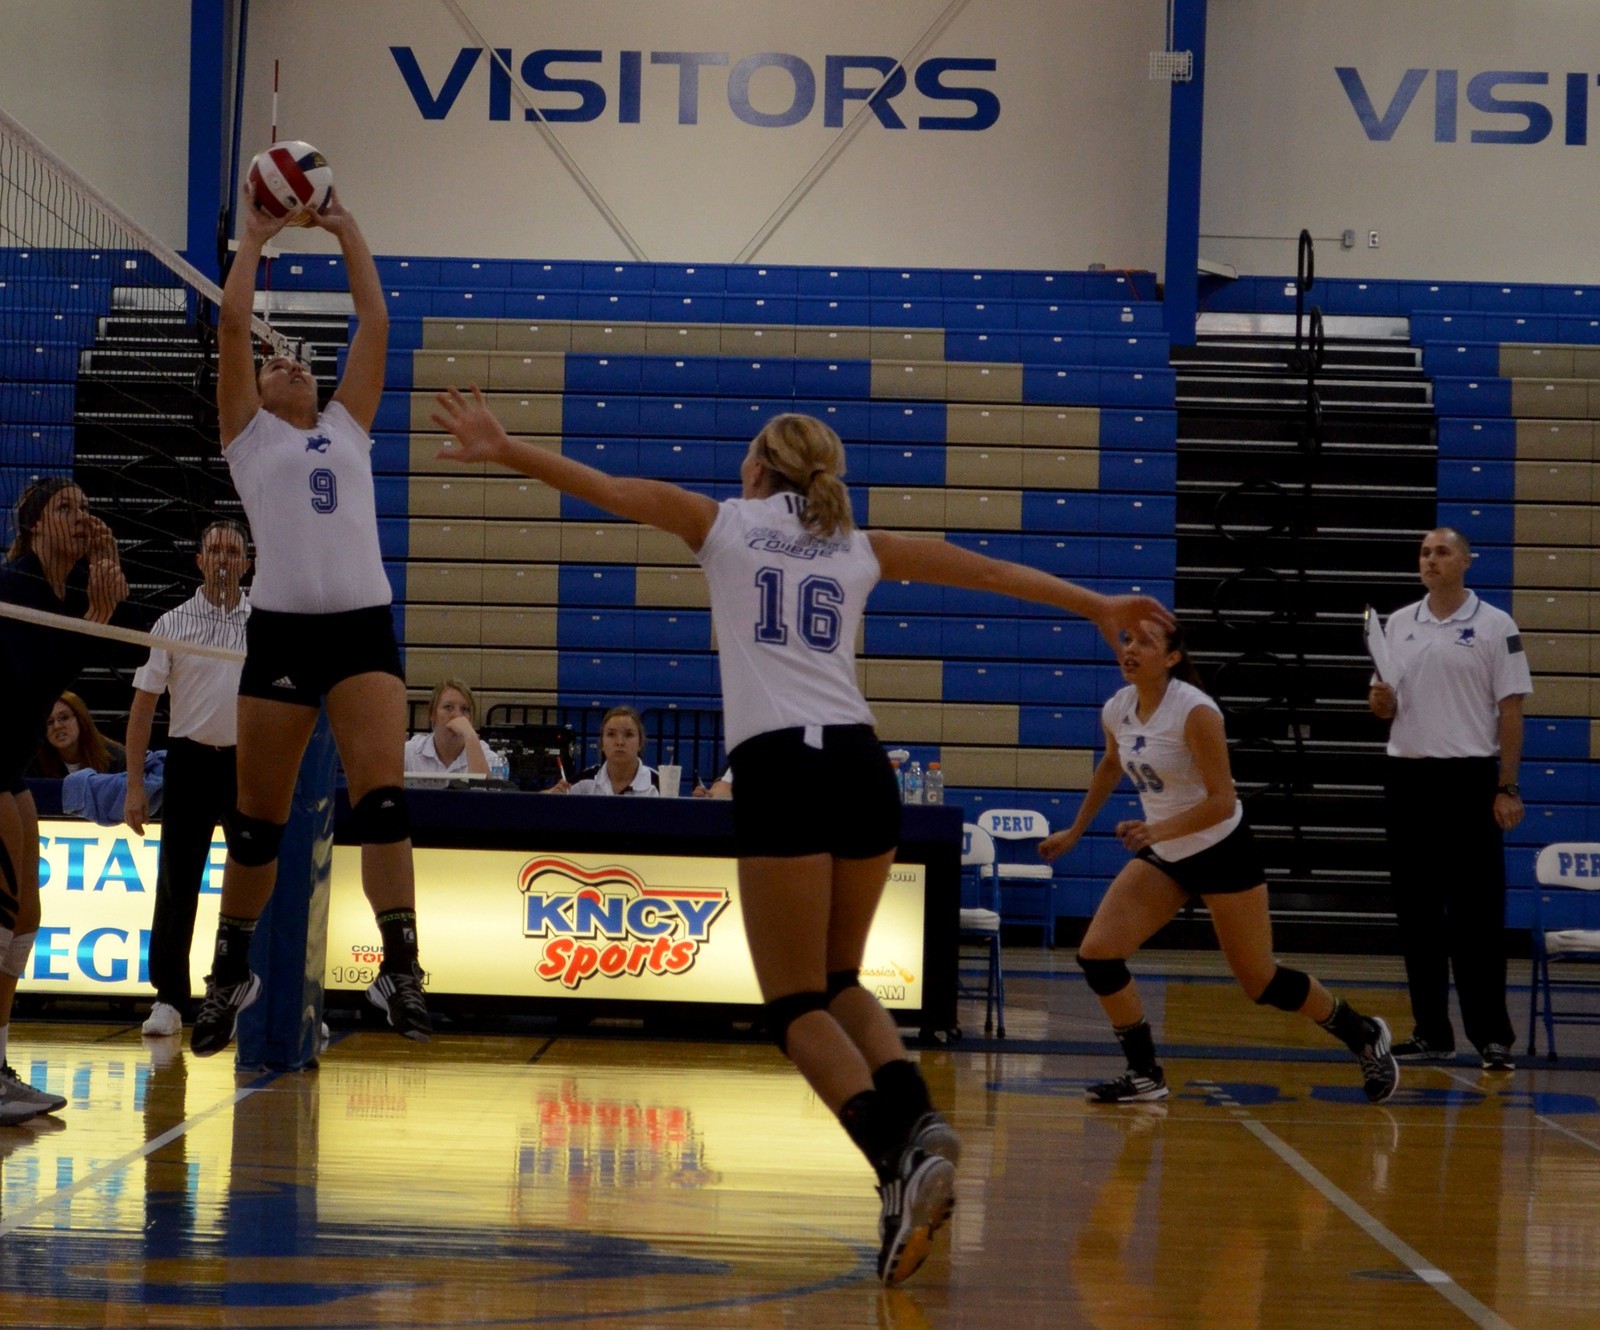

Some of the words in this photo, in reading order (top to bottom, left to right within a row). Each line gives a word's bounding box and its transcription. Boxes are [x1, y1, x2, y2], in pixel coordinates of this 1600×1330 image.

[388, 46, 1001, 131] VISITORS
[1334, 66, 1600, 147] VISI
[309, 468, 338, 514] 9
[755, 566, 845, 653] 16
[991, 815, 1034, 832] PERU
[525, 891, 727, 942] KNCY
[332, 966, 375, 983] 103
[536, 936, 699, 989] Sports
[874, 984, 906, 1001] AM
